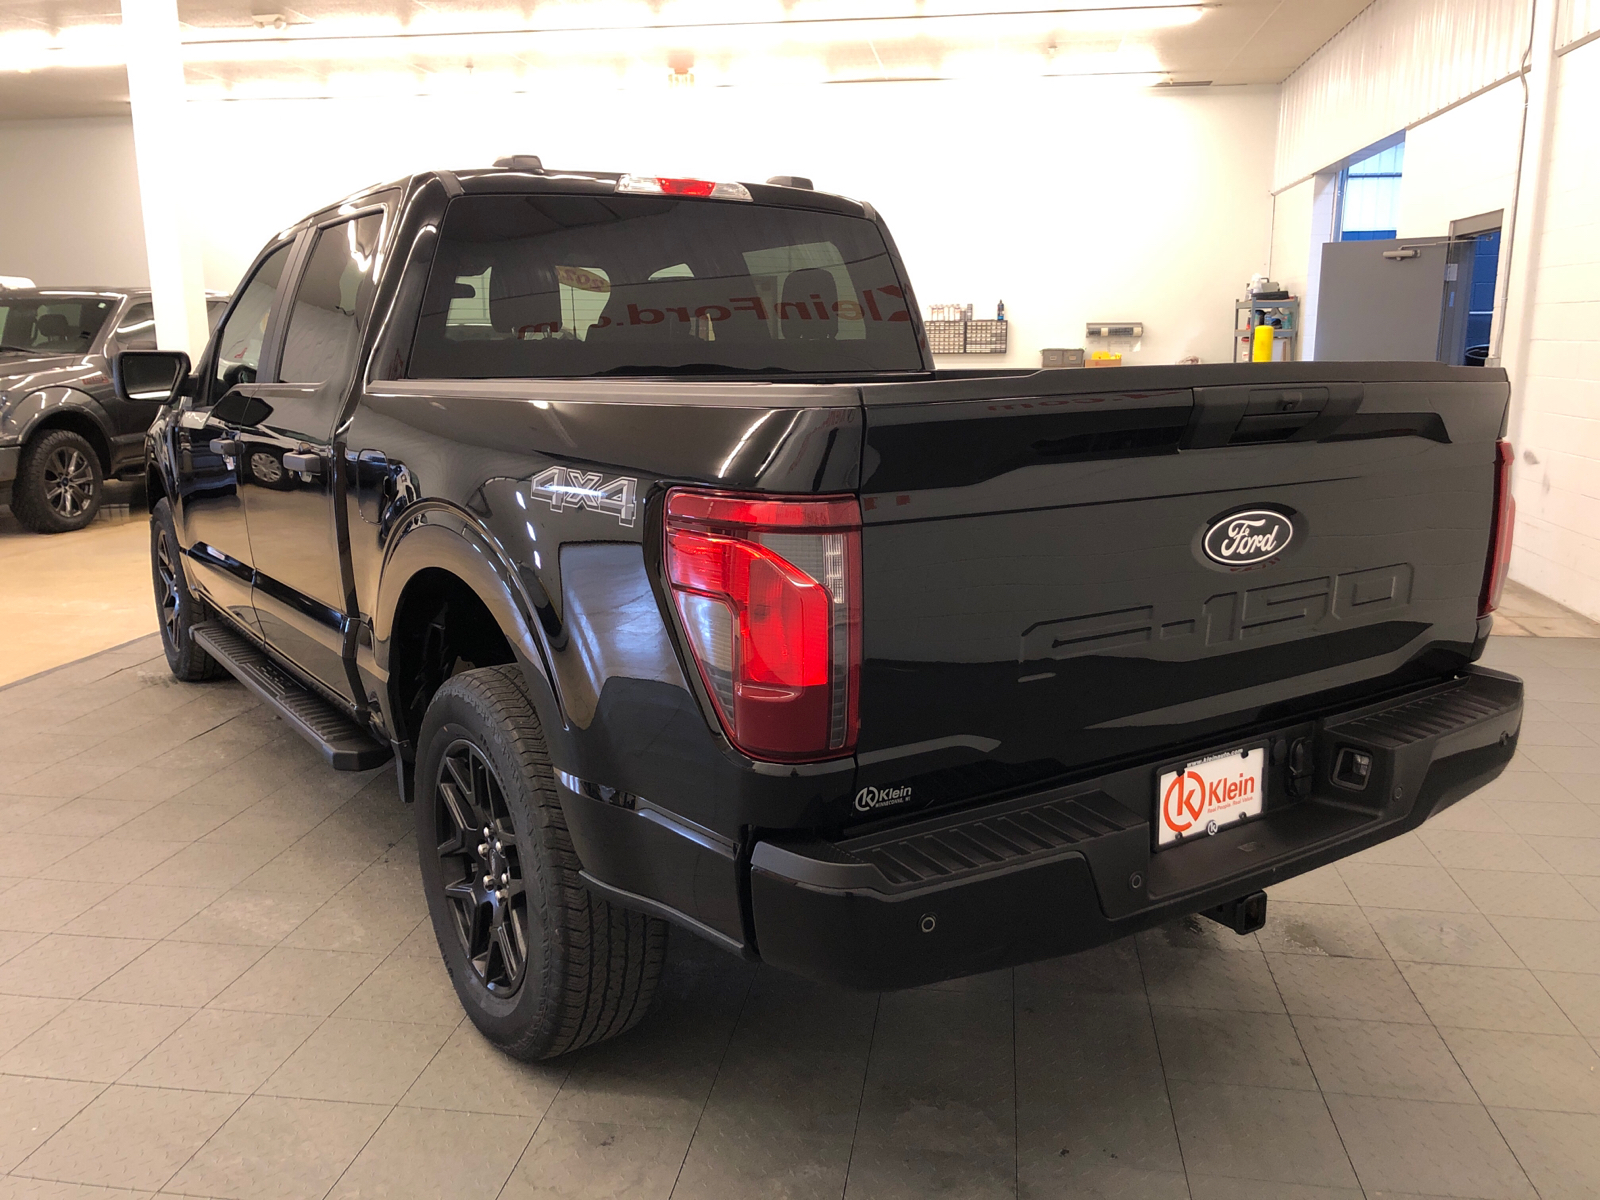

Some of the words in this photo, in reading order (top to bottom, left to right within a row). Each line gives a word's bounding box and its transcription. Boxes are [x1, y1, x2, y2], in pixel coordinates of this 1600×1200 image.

[1221, 519, 1279, 557] Ford
[1017, 562, 1414, 682] F-150
[879, 785, 912, 801] Klein
[1208, 773, 1255, 807] Klein
